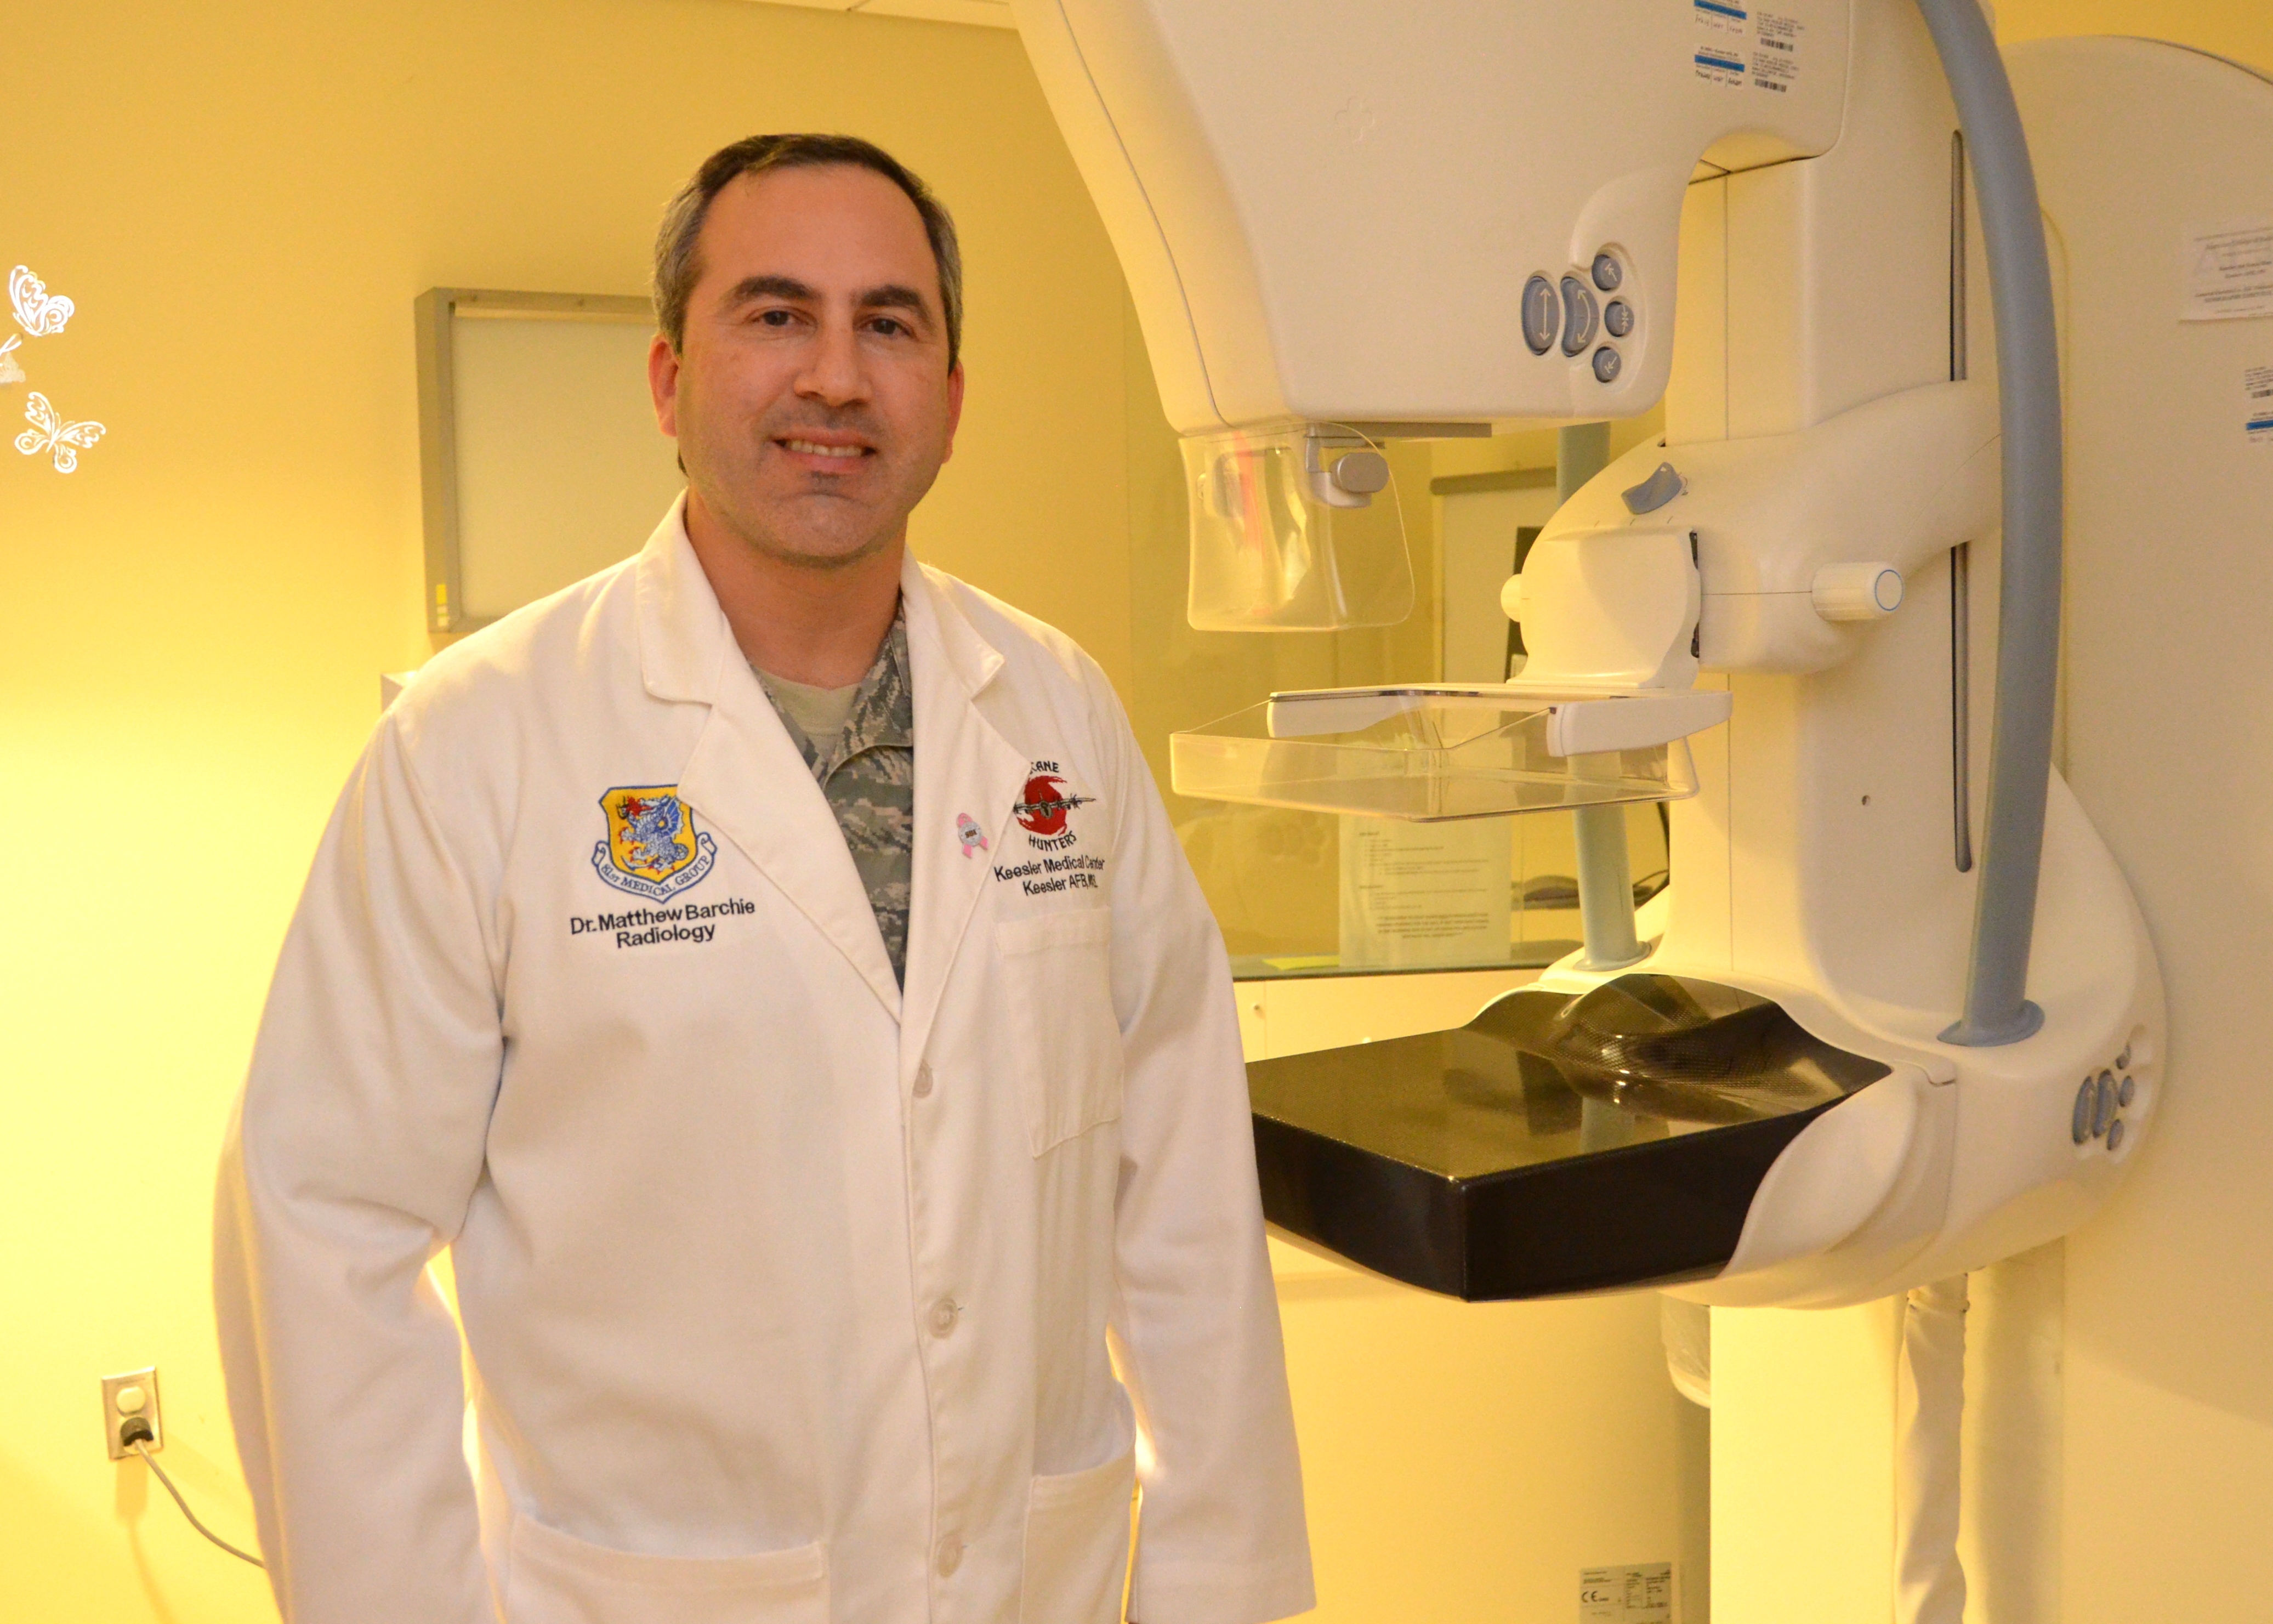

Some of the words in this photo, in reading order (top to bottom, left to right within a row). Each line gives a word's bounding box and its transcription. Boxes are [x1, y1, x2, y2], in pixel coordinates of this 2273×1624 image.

[1028, 831, 1077, 851] HUNTERS
[621, 877, 675, 896] MEDICAL
[675, 855, 710, 885] GROUP
[994, 861, 1042, 882] Keesler
[1043, 855, 1084, 873] Medical
[1022, 878, 1066, 896] Keesler
[685, 898, 755, 920] Barchie
[616, 924, 716, 949] Radiology
